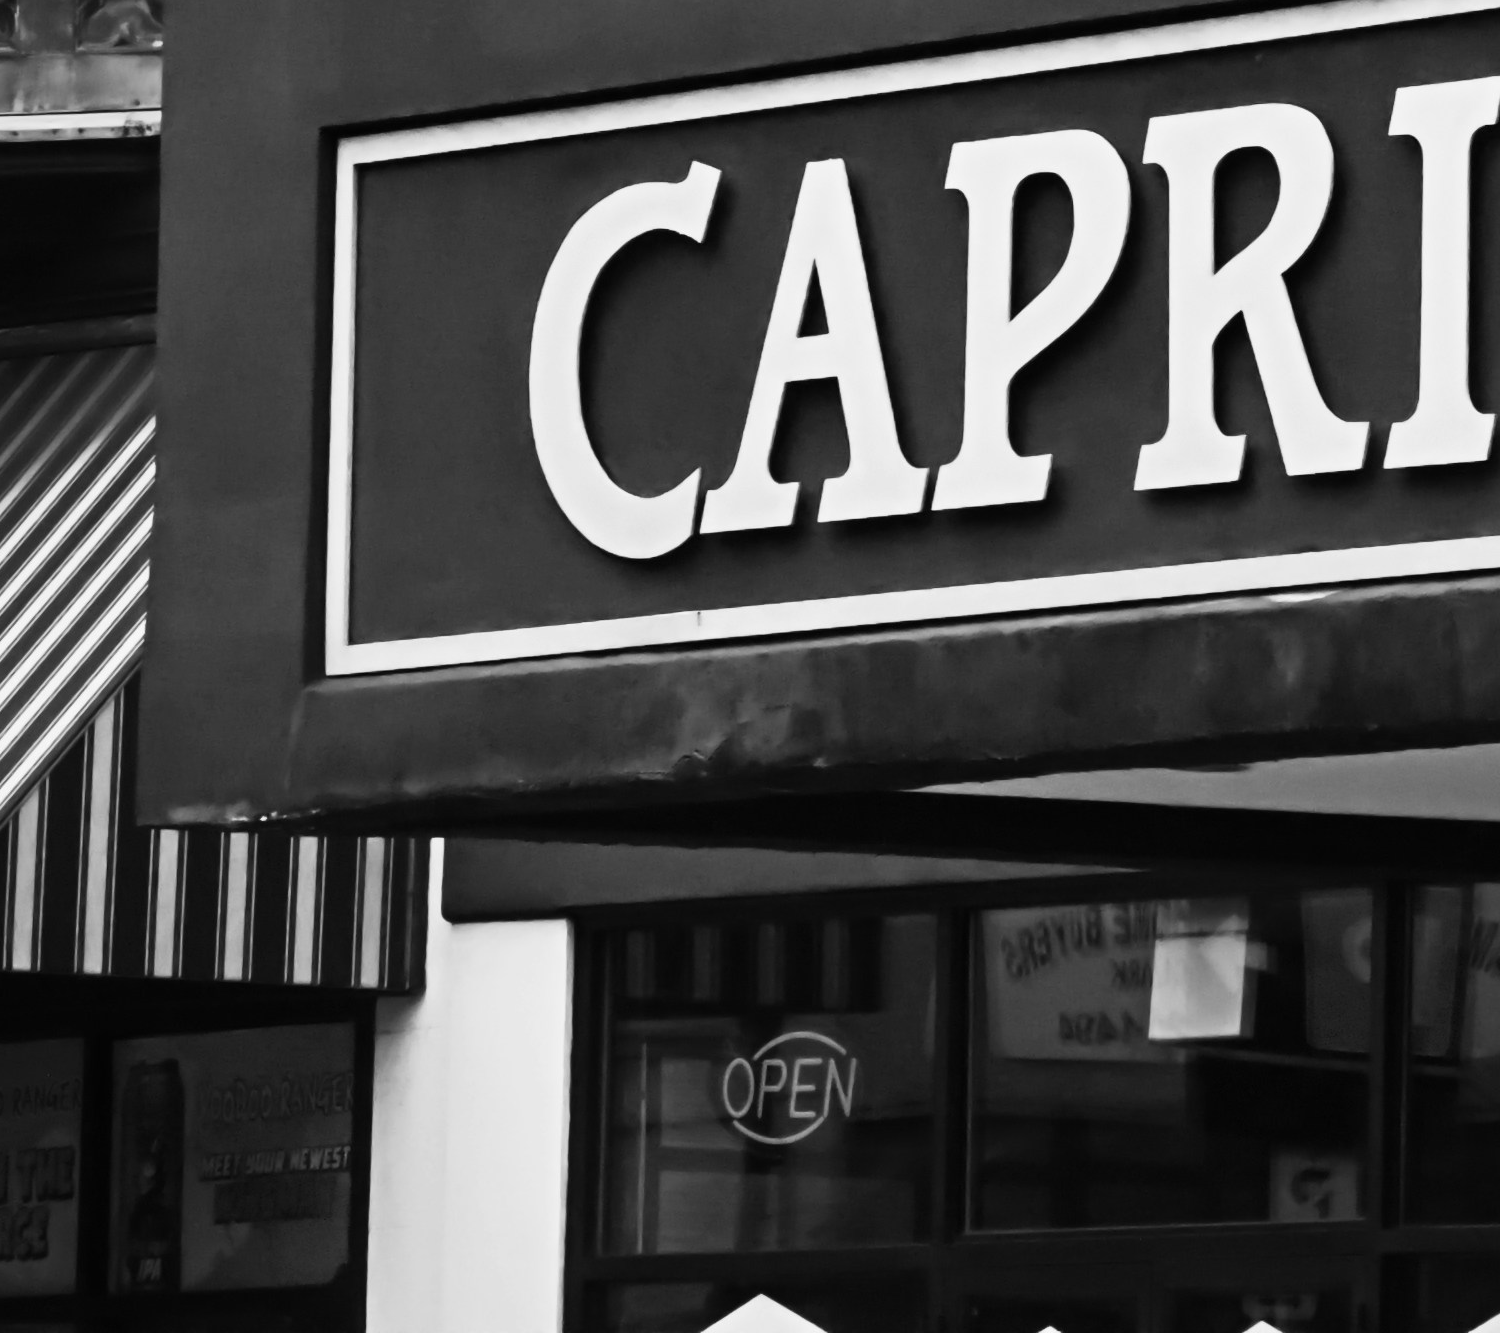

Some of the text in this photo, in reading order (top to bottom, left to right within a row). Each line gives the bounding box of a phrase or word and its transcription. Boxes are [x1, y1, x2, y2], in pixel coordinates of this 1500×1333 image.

[12, 1078, 83, 1116] RANGER
[197, 1071, 354, 1124] VOODOO RANGER
[722, 1056, 857, 1119] OPEN
[15, 1145, 76, 1203] THE
[202, 1154, 241, 1179] MEET
[289, 1145, 352, 1170] NEWEST
